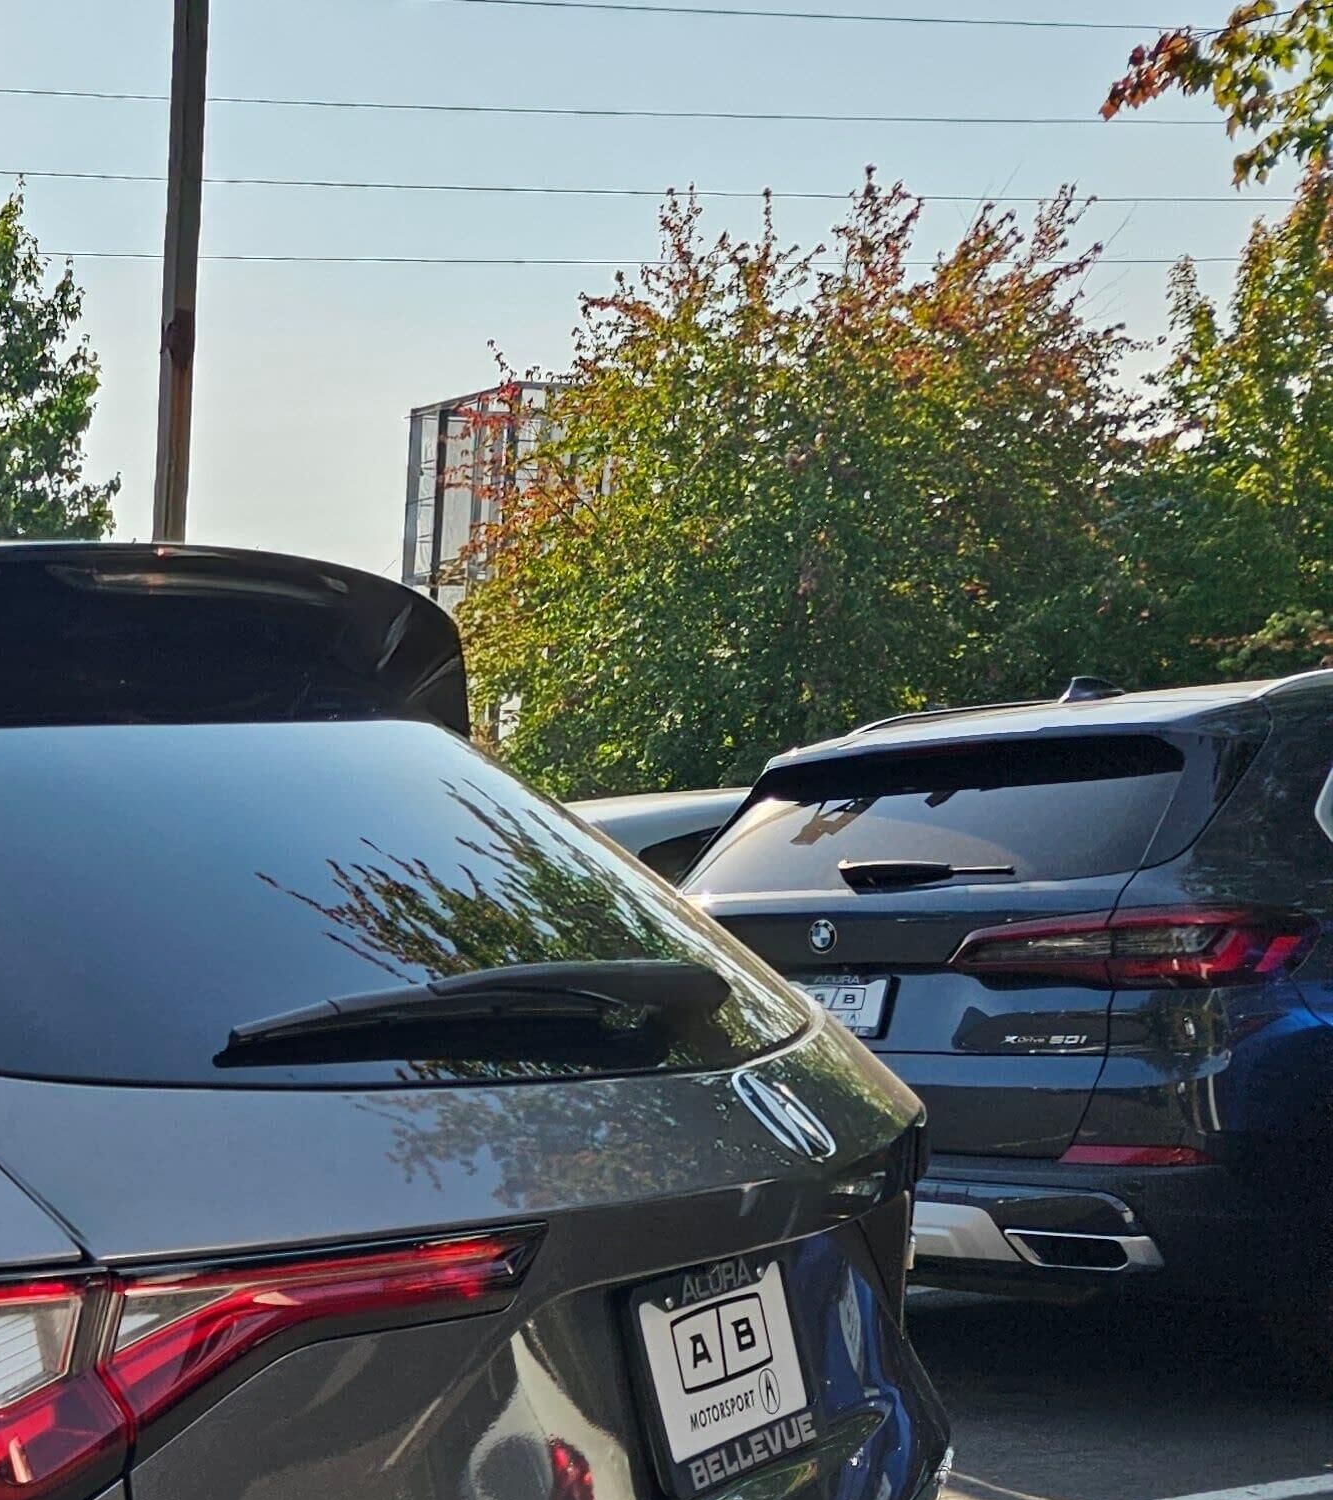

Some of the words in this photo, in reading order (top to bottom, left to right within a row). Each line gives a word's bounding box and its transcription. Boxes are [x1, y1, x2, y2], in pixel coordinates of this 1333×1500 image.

[814, 975, 860, 984] ACURA
[843, 994, 855, 1004] B
[682, 1257, 753, 1303] ACURA
[689, 1333, 713, 1370] A
[730, 1316, 757, 1353] B
[689, 1389, 756, 1432] MOTORSPORT
[688, 1411, 818, 1491] BELLEVUE
